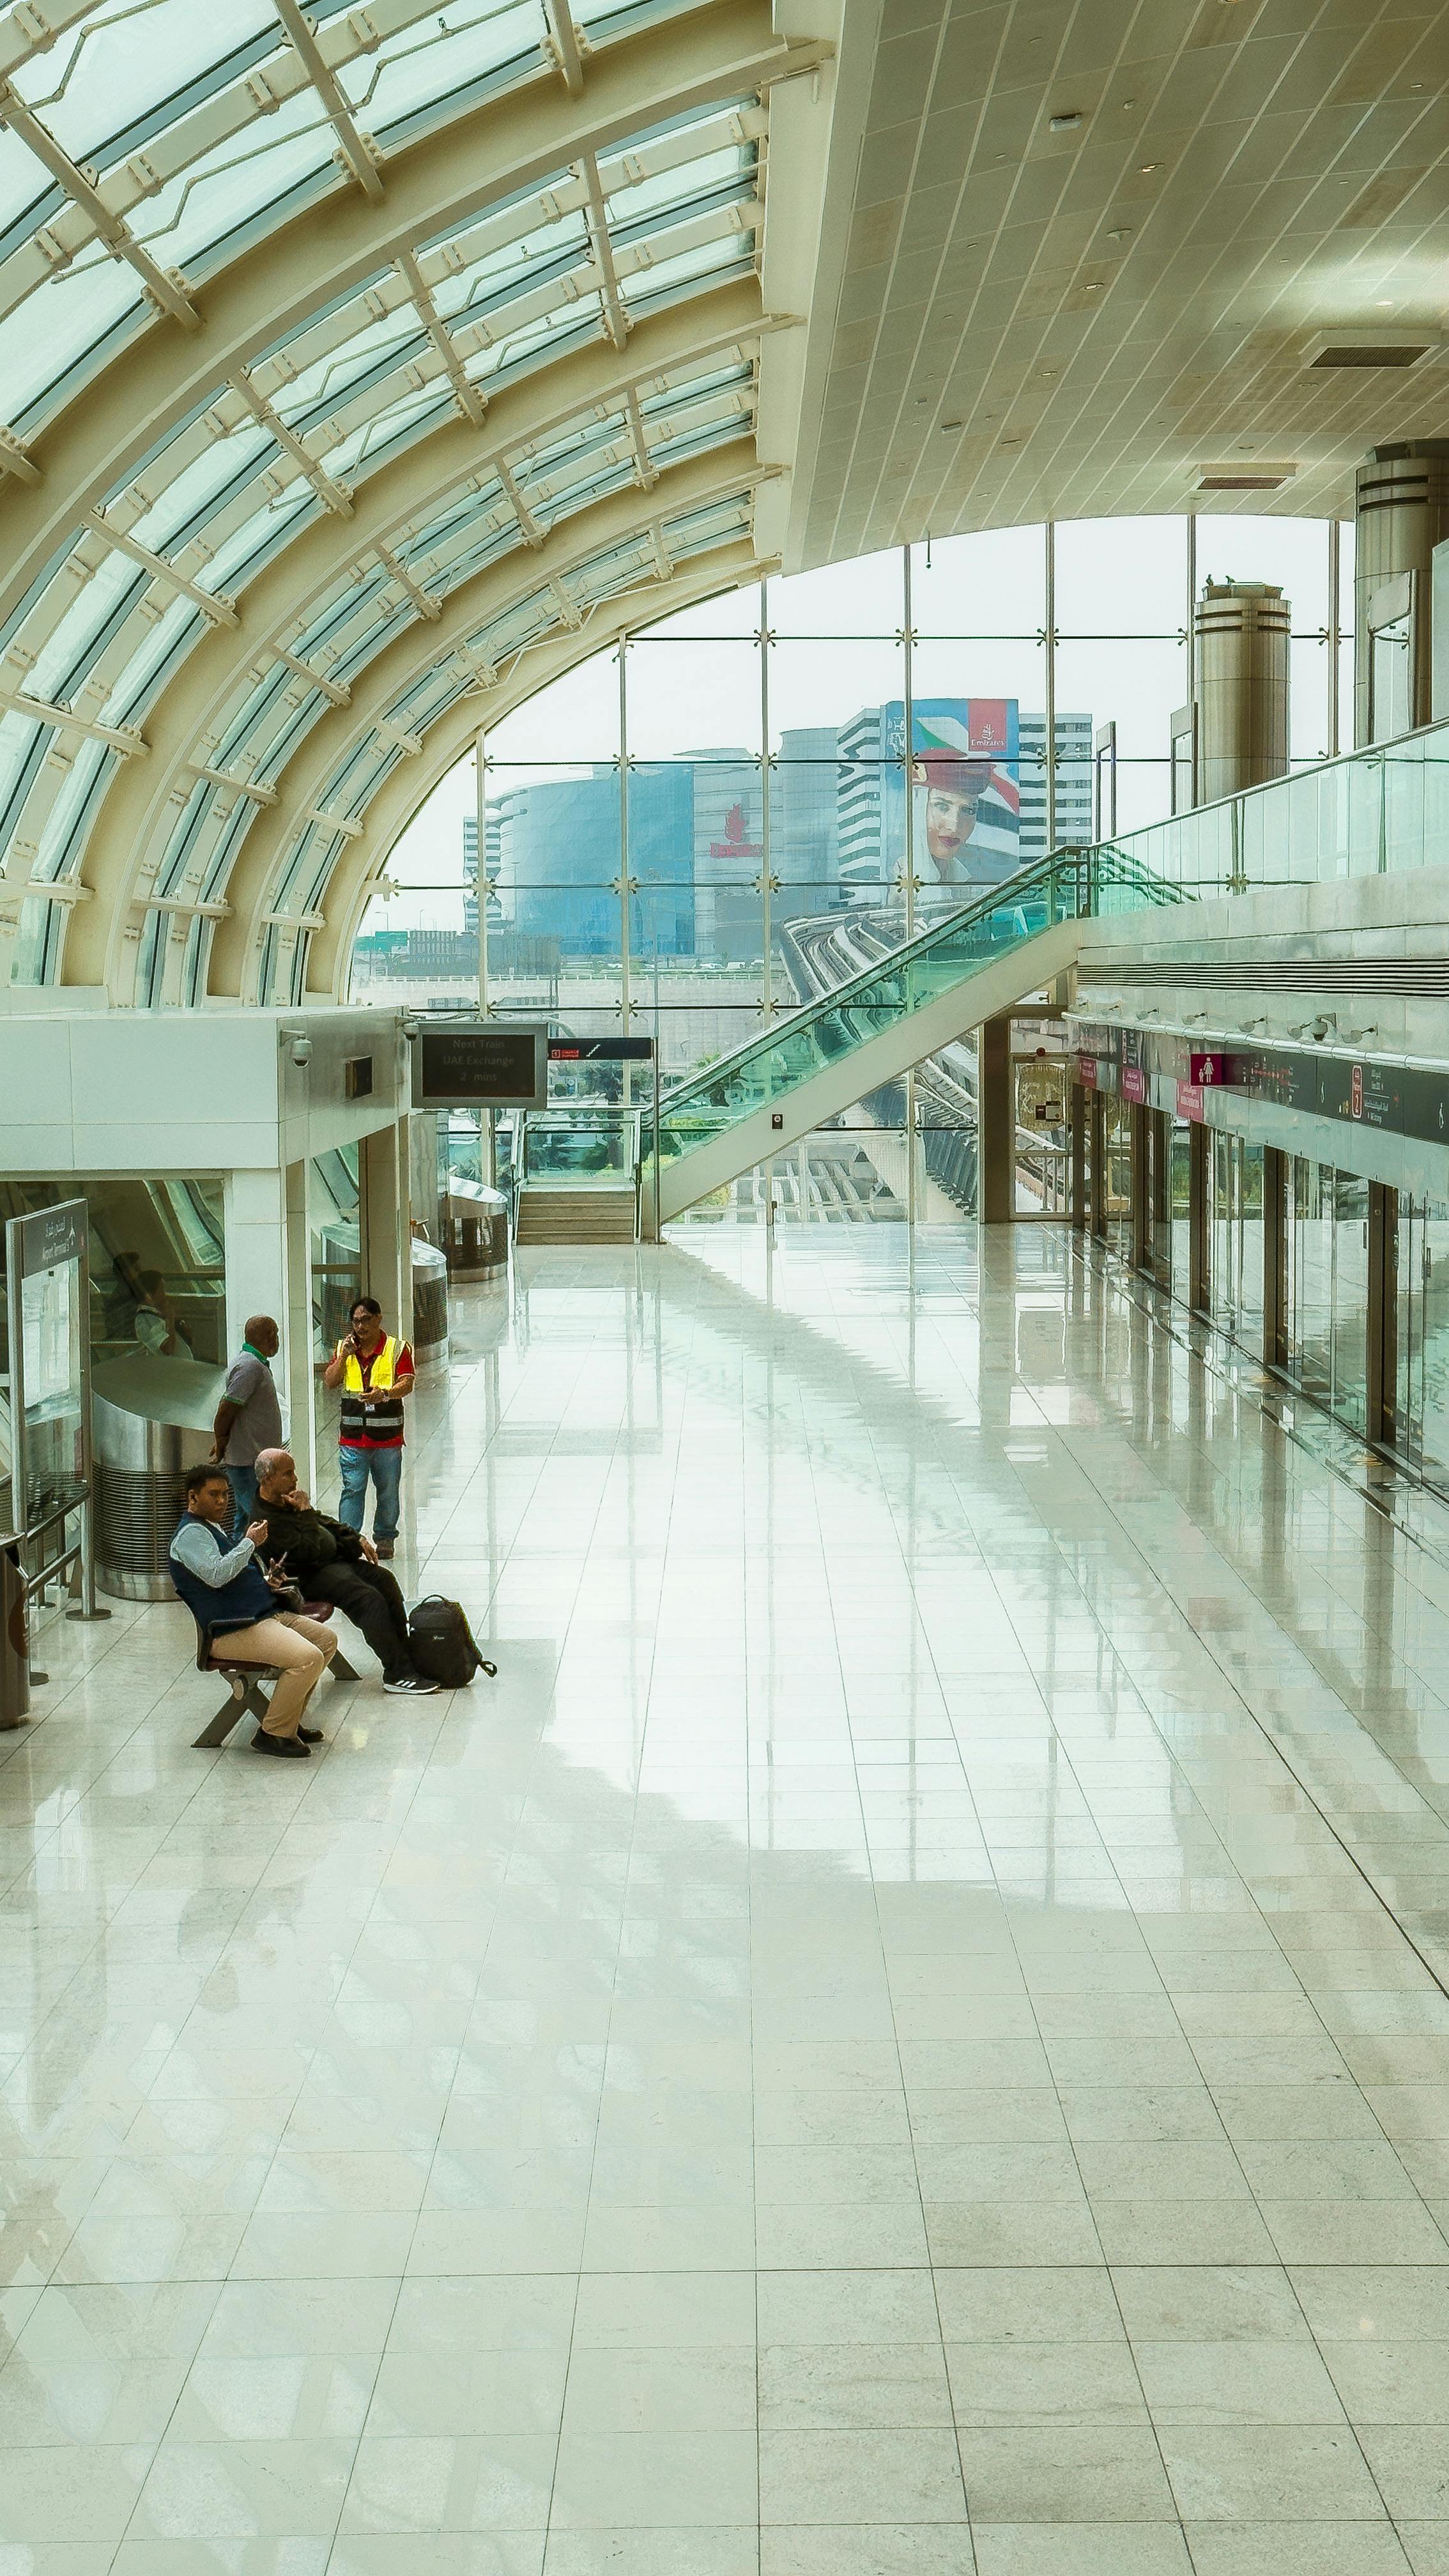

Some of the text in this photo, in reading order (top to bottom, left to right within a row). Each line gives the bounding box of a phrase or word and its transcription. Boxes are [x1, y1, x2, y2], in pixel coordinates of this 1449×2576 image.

[452, 1039, 505, 1048] Next Train
[443, 1055, 515, 1068] UAE Exchange
[460, 1072, 498, 1082] 2 mins
